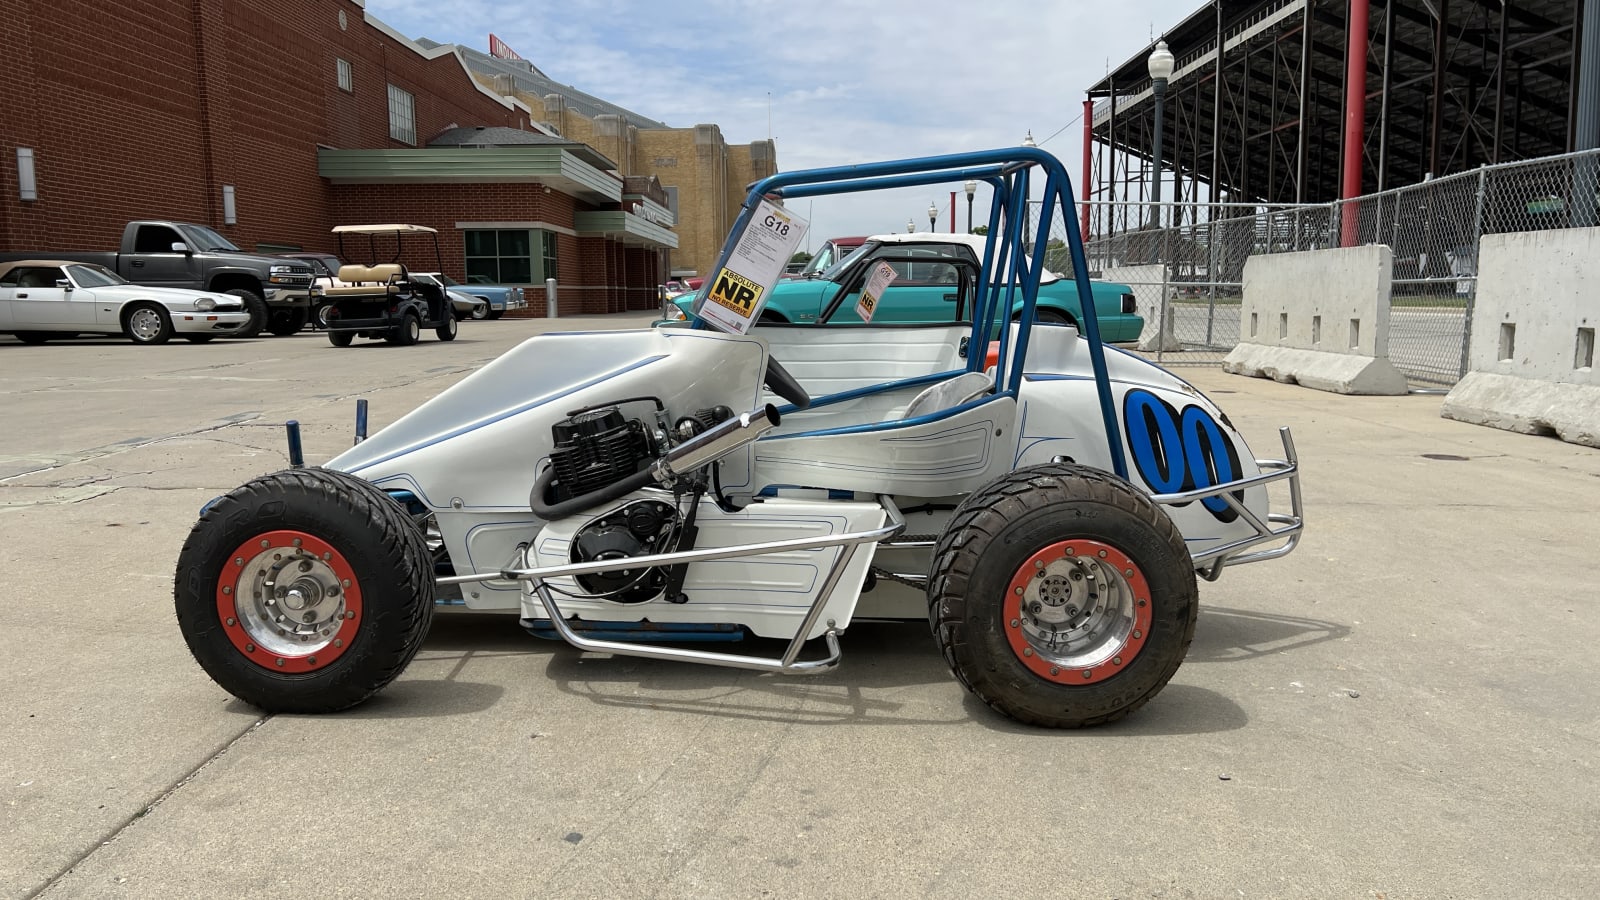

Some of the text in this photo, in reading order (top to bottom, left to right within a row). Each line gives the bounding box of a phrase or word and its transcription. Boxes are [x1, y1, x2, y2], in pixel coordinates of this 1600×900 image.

[765, 215, 790, 236] G18
[723, 270, 760, 292] ABSOLUTE
[715, 276, 756, 310] NR
[862, 294, 874, 310] NR
[711, 294, 748, 315] NO RESERVE
[1123, 388, 1244, 523] 00
